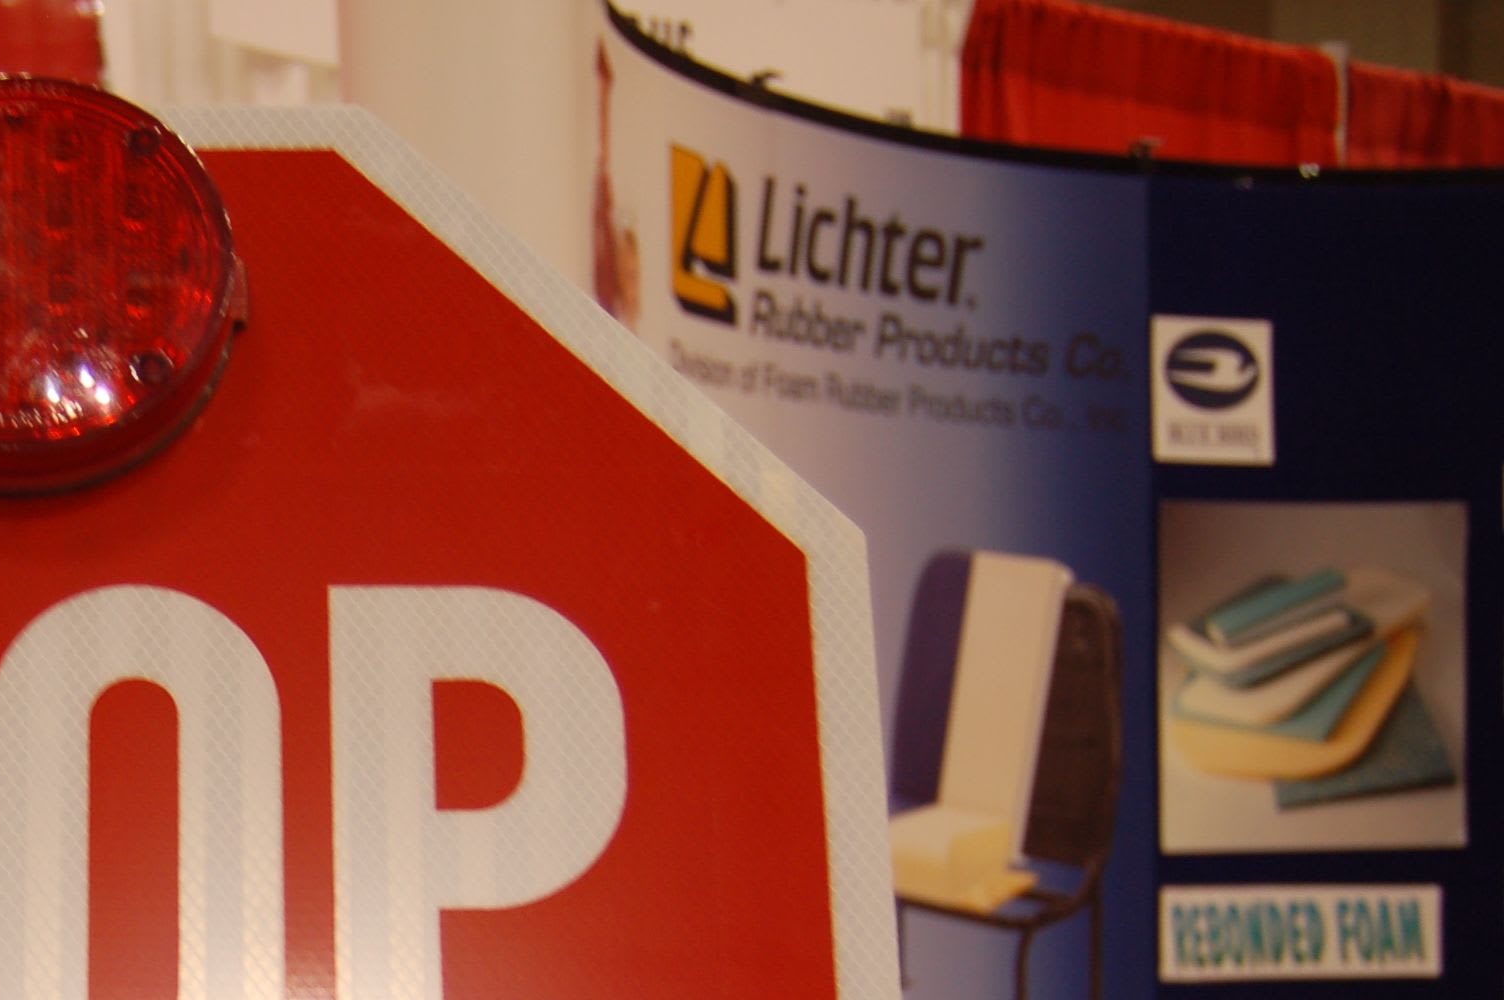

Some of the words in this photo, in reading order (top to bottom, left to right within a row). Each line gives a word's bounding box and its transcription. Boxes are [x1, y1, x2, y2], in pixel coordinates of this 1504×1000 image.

[749, 290, 866, 352] Rubber
[873, 312, 1050, 377] Products
[1065, 330, 1133, 380] Co.
[1171, 899, 1324, 967] REBONDED
[1336, 897, 1426, 963] FOAM
